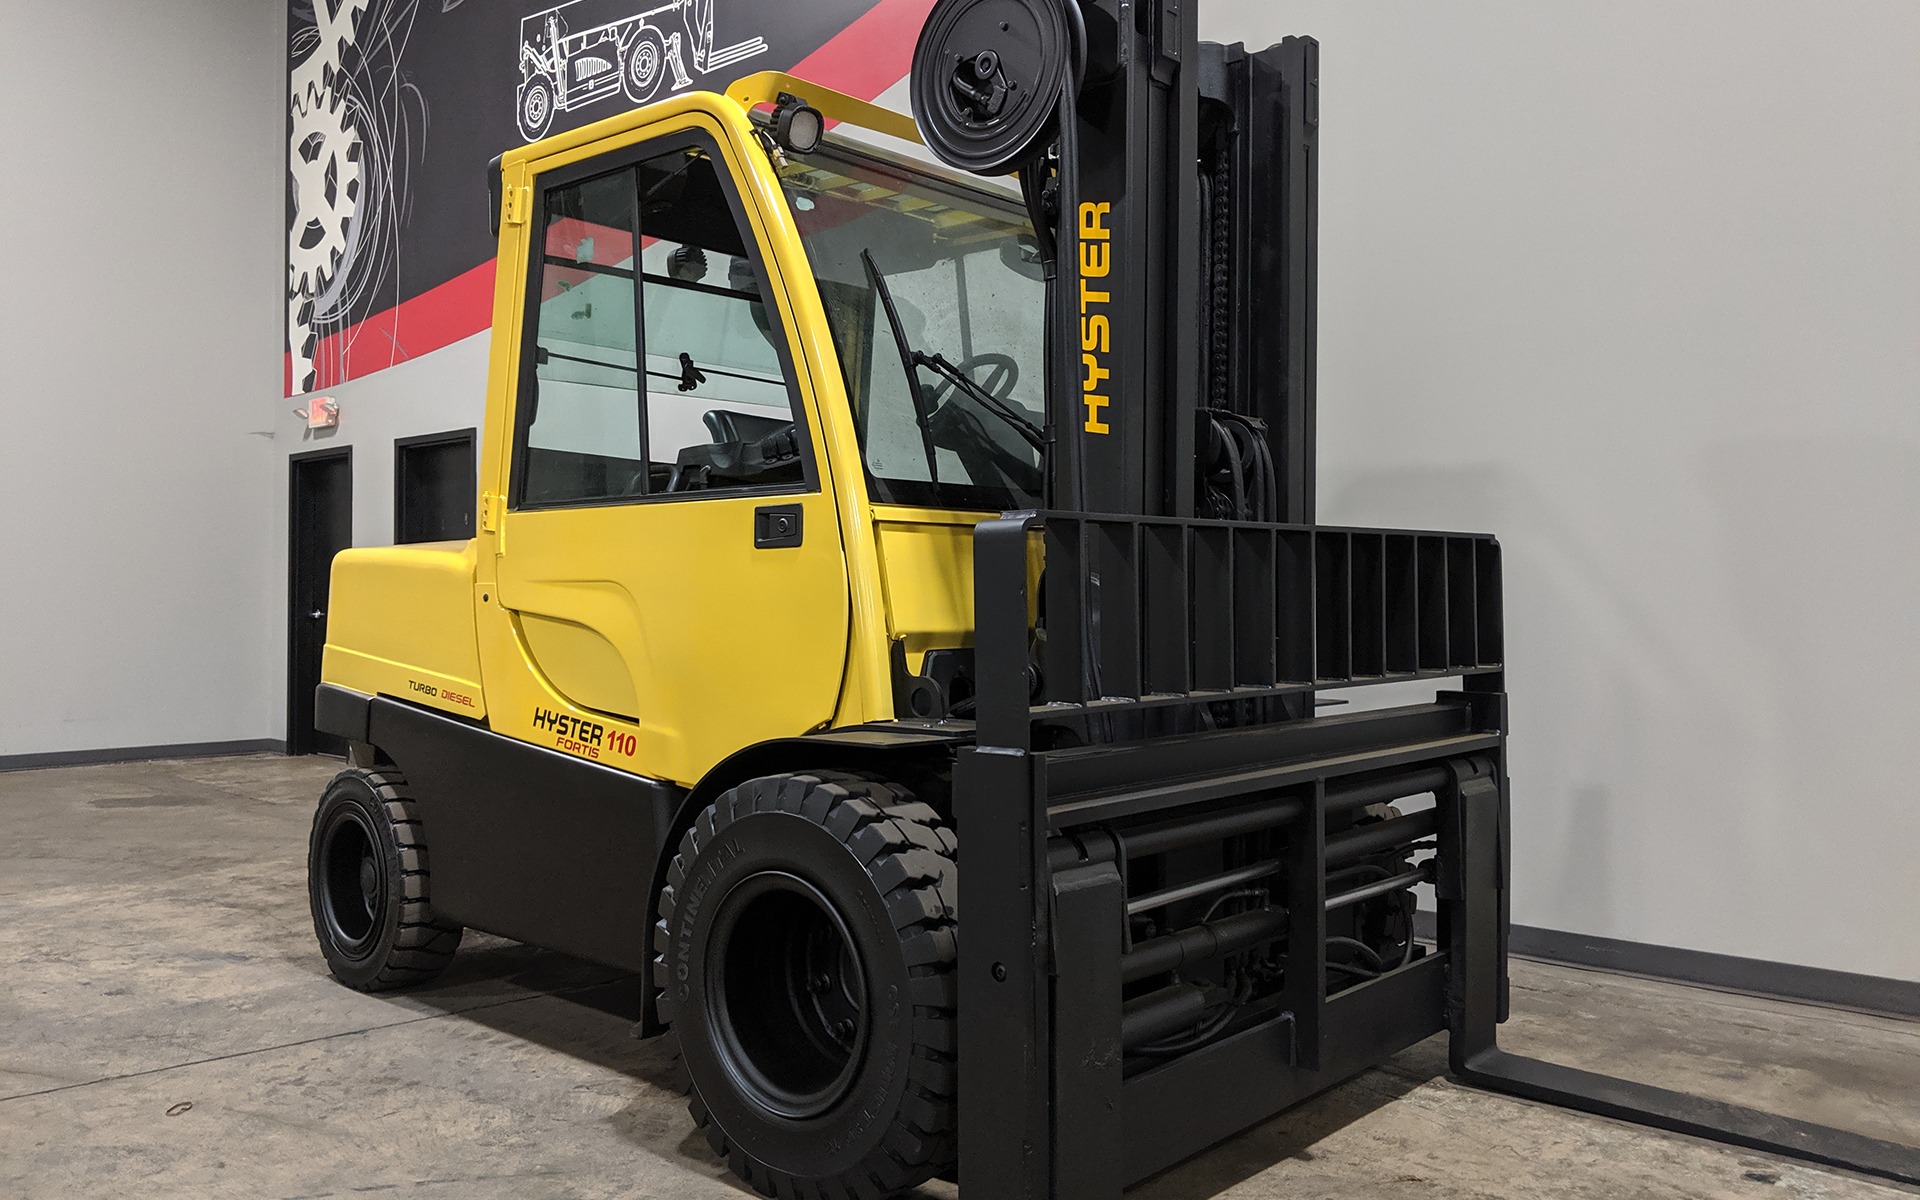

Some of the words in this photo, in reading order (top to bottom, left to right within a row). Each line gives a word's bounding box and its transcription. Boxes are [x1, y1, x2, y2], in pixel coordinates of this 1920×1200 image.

[1079, 201, 1110, 435] HYSTER
[408, 680, 438, 697] TURBO
[441, 689, 476, 708] DIESEL
[533, 707, 603, 747] HYSTER
[606, 730, 637, 757] 110
[556, 737, 600, 759] FORTIS
